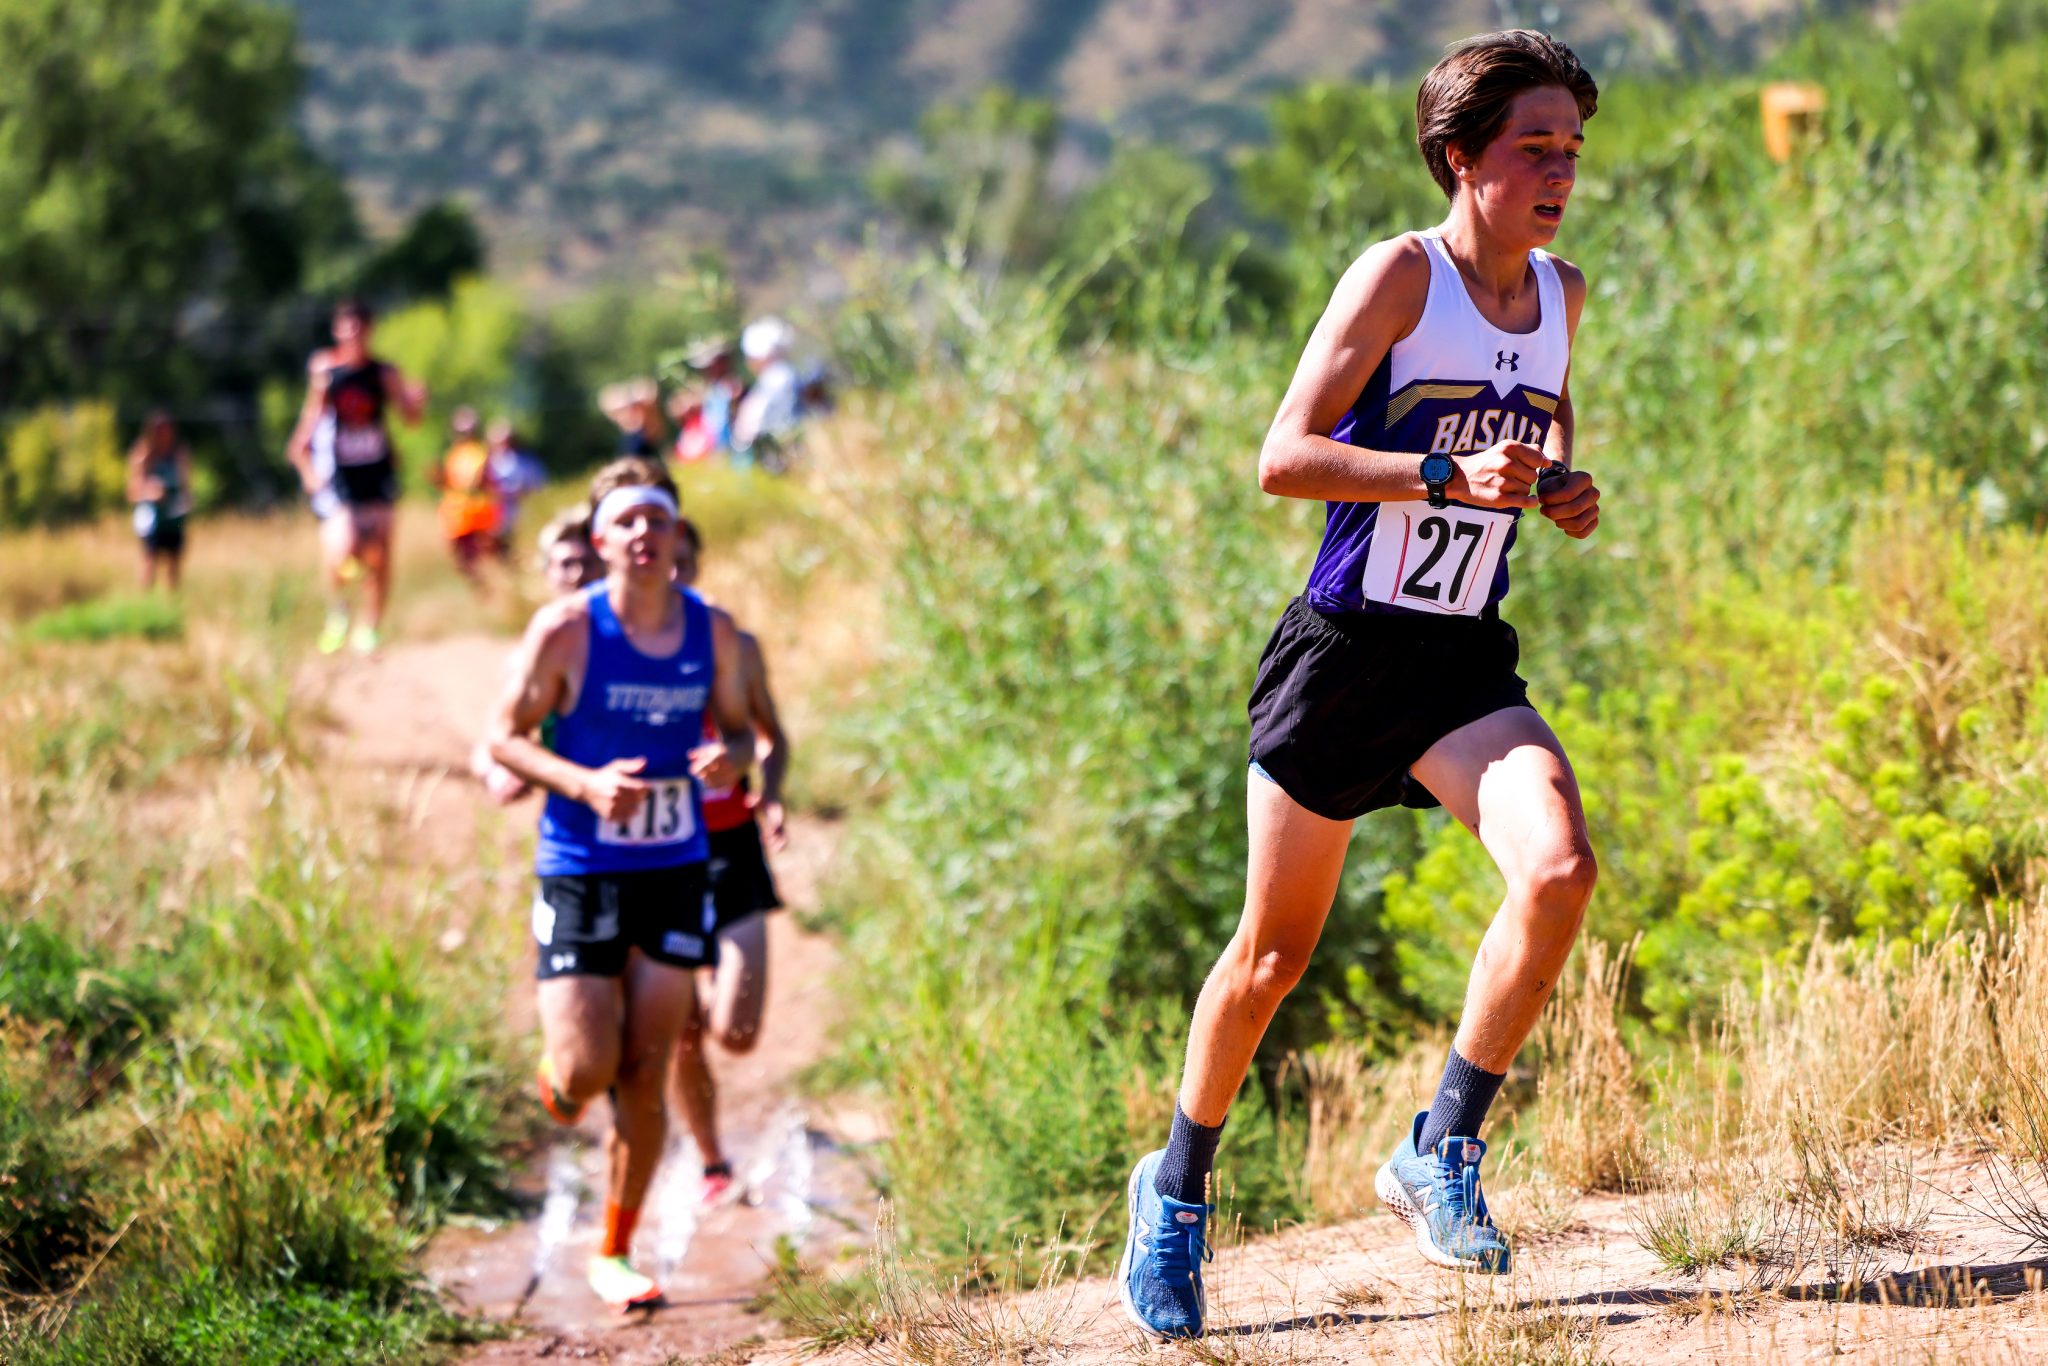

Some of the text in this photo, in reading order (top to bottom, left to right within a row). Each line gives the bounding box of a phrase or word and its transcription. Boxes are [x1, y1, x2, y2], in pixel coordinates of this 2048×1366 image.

[1429, 409, 1542, 454] BASALT
[1401, 516, 1484, 604] 27
[606, 684, 705, 712] TITANS
[615, 785, 679, 838] 13
